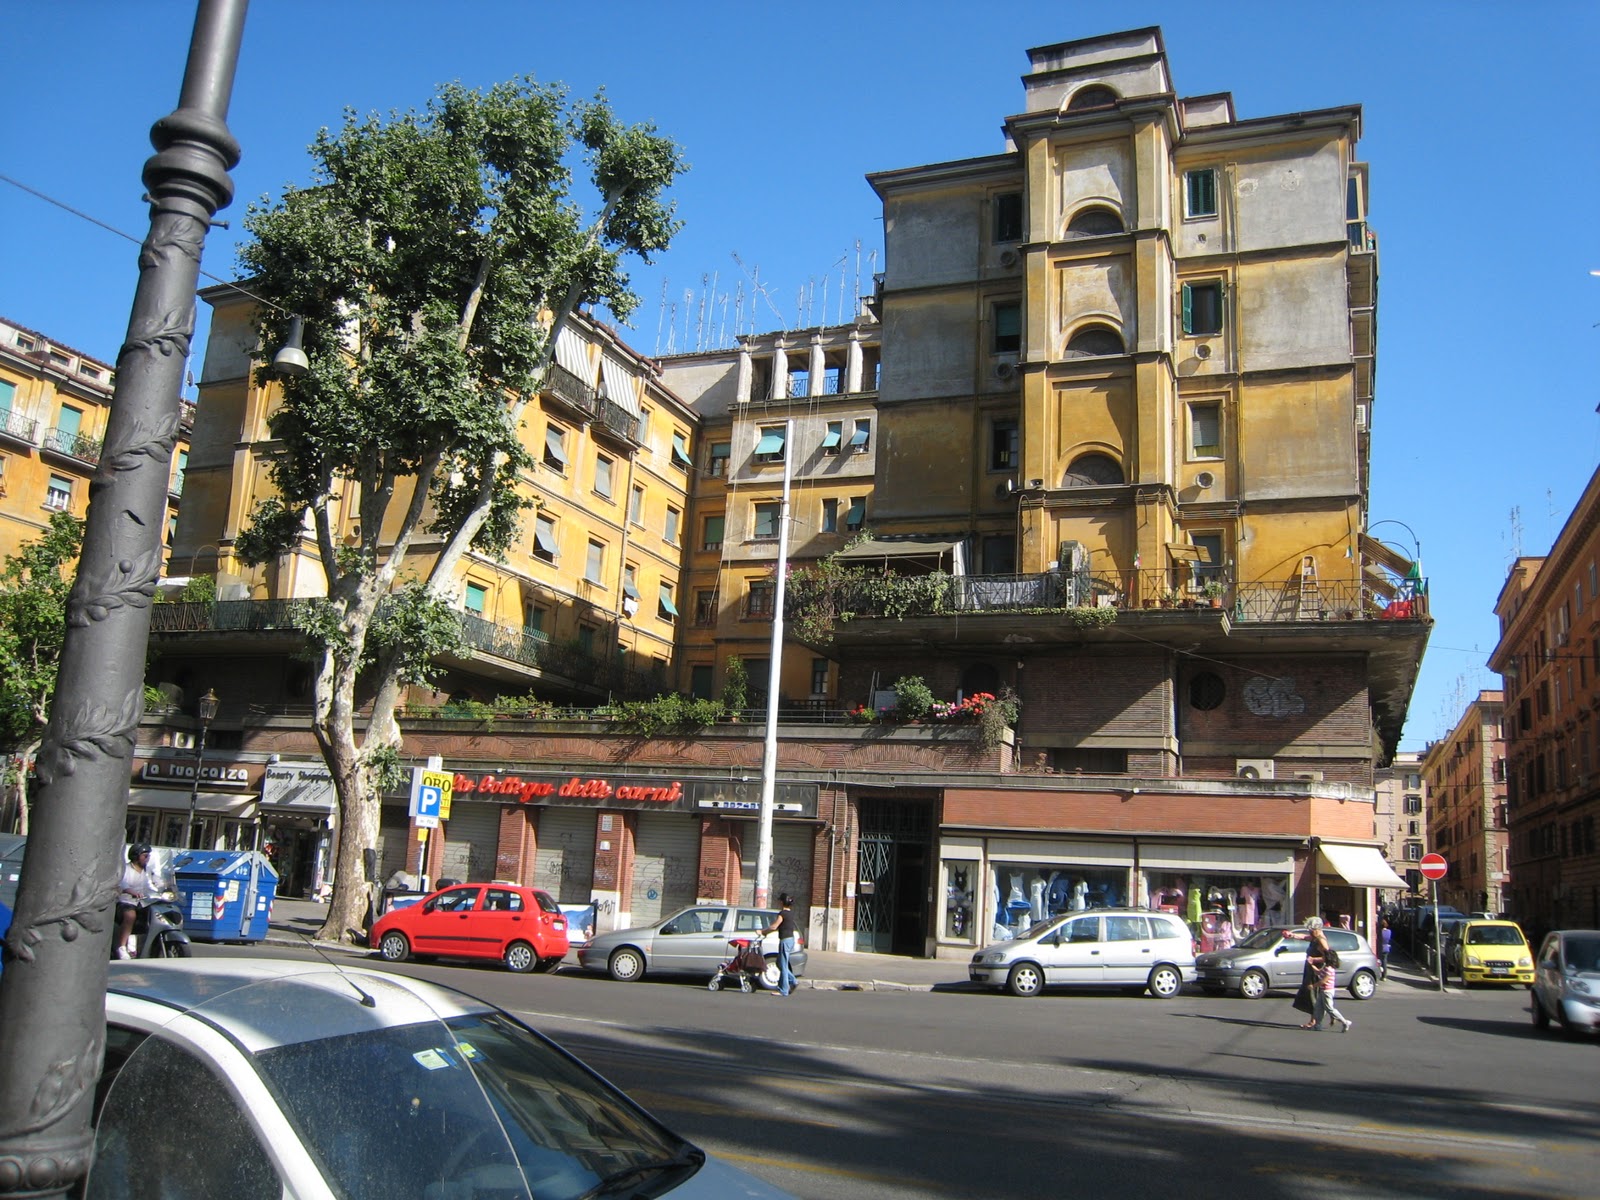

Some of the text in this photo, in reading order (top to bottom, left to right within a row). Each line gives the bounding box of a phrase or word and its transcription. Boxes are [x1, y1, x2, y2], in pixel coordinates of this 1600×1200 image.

[200, 767, 249, 780] calza
[266, 768, 294, 782] Beauty
[423, 776, 452, 793] ORO
[478, 775, 554, 802] bottega
[558, 777, 613, 799] delle
[616, 781, 683, 802] carni
[421, 788, 437, 813] P
